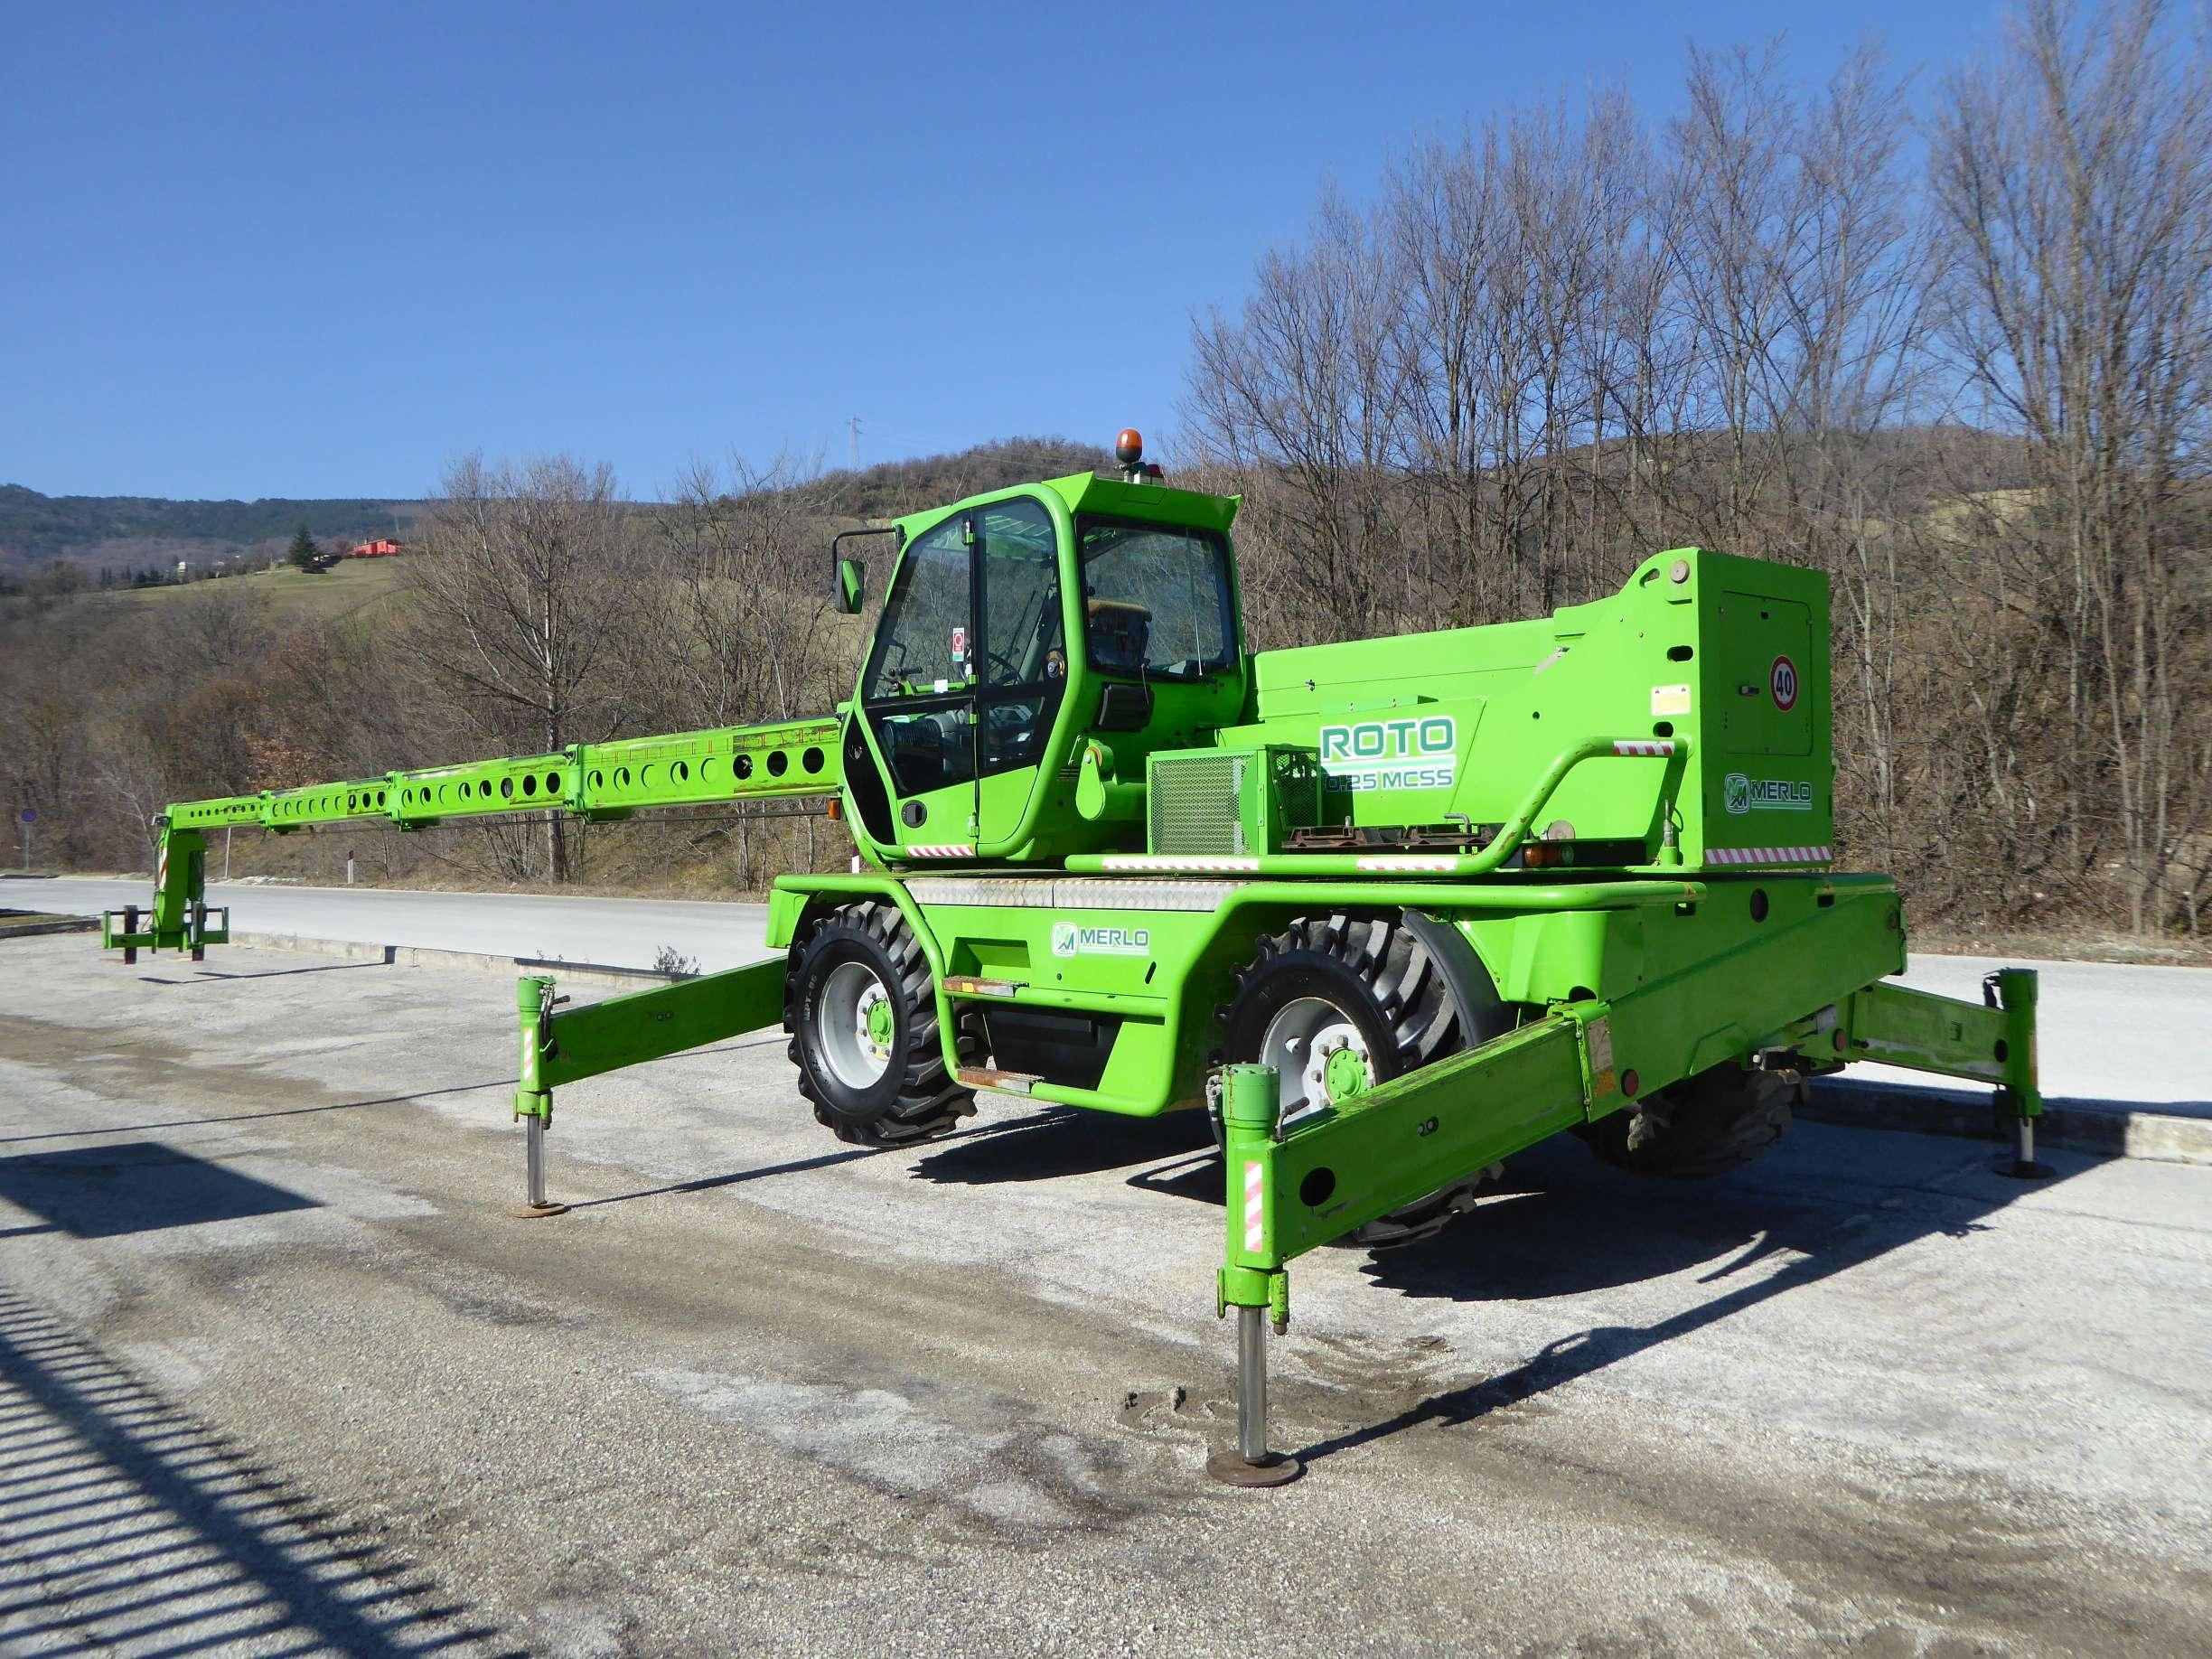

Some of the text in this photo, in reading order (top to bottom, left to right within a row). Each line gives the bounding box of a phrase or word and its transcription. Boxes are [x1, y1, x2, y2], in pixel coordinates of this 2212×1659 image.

[1776, 670, 1793, 696] 40
[1321, 717, 1454, 761] ROTO
[1324, 769, 1453, 792] 0.25 MCSS
[1751, 780, 1812, 801] MERLO
[1079, 928, 1149, 947] MERLO
